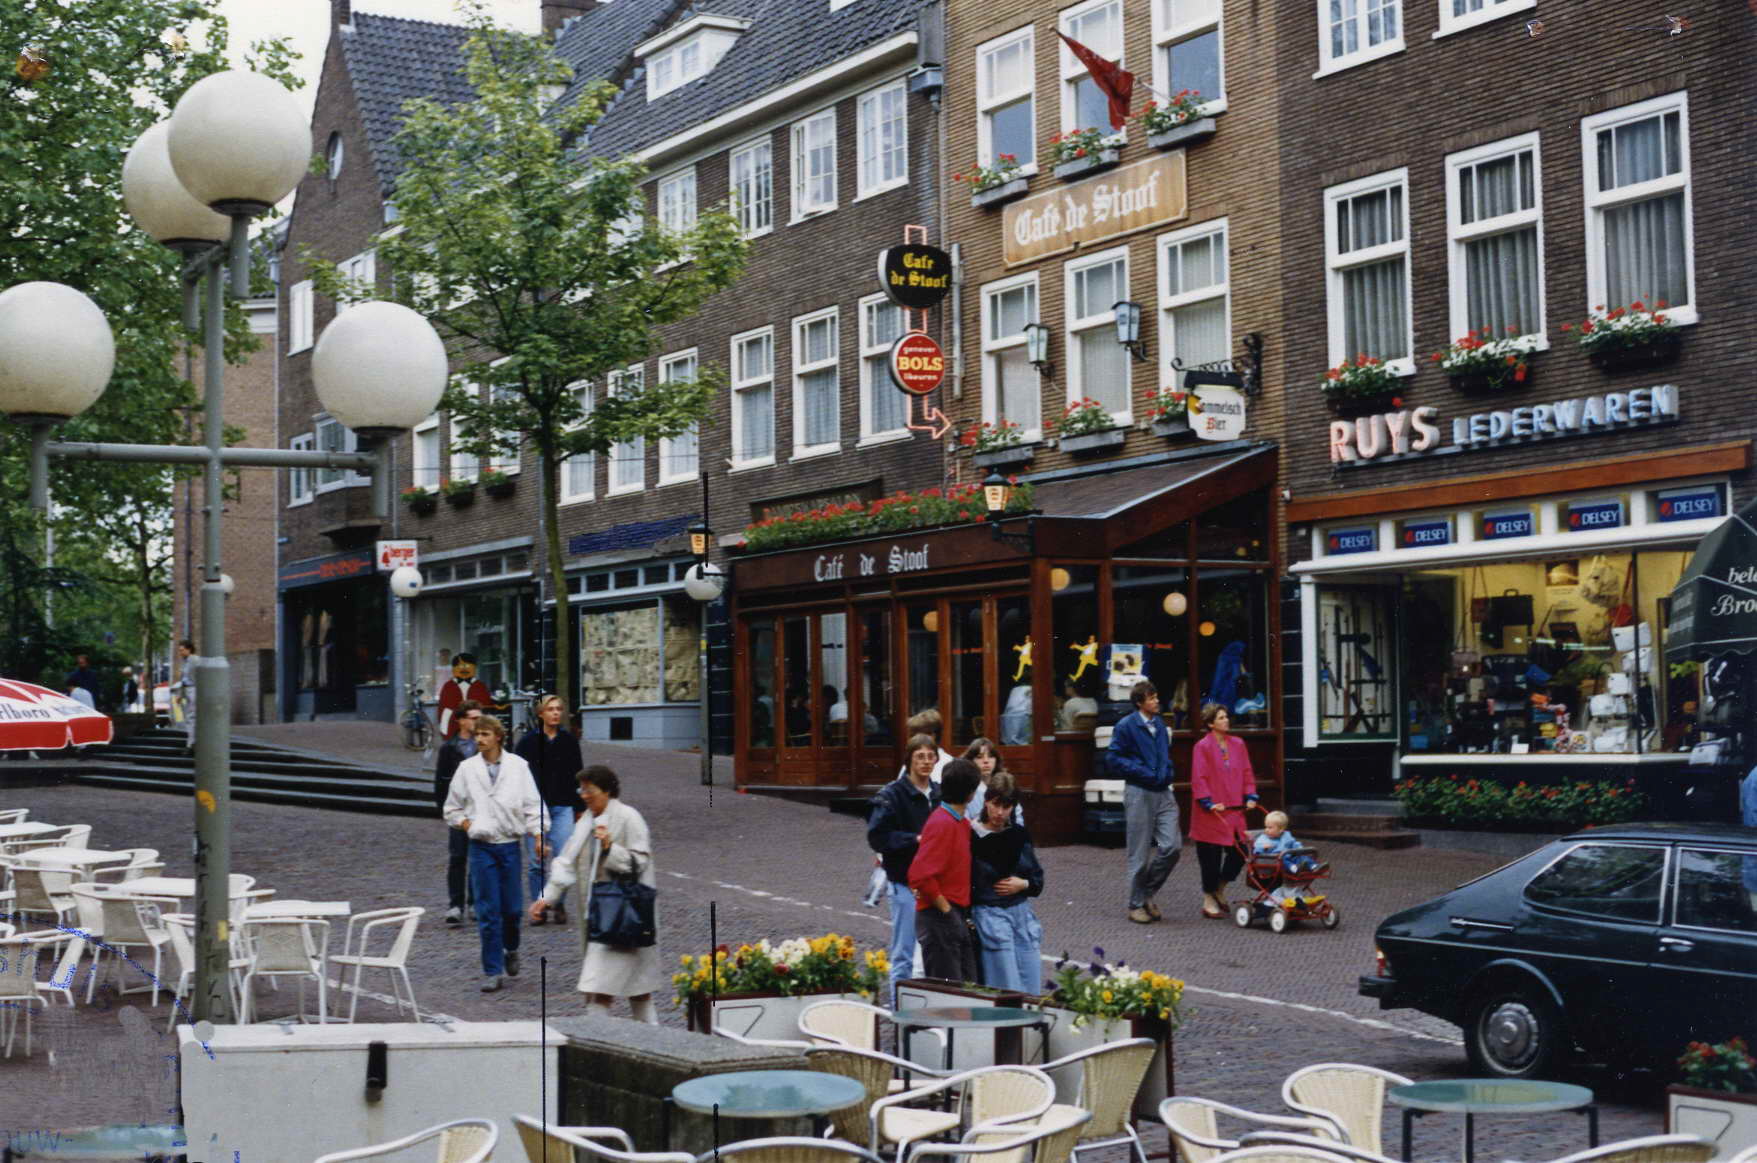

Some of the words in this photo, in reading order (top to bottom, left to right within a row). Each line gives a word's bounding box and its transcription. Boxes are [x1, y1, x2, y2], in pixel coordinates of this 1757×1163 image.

[1065, 194, 1088, 232] de
[1092, 169, 1161, 224] Stoof
[898, 356, 943, 371] BOLS
[1330, 406, 1440, 463] RUYS
[1453, 384, 1680, 445] LEDERWAREN
[1674, 498, 1714, 515] DELSEY
[1581, 510, 1619, 526] DELSEY
[1495, 519, 1530, 535] DELSEY
[1339, 534, 1373, 549] DELSEY
[1415, 528, 1446, 543] DELSEY
[814, 554, 844, 582] Café
[860, 553, 875, 576] de
[887, 544, 929, 574] Stoof
[1711, 594, 1757, 616] Bro
